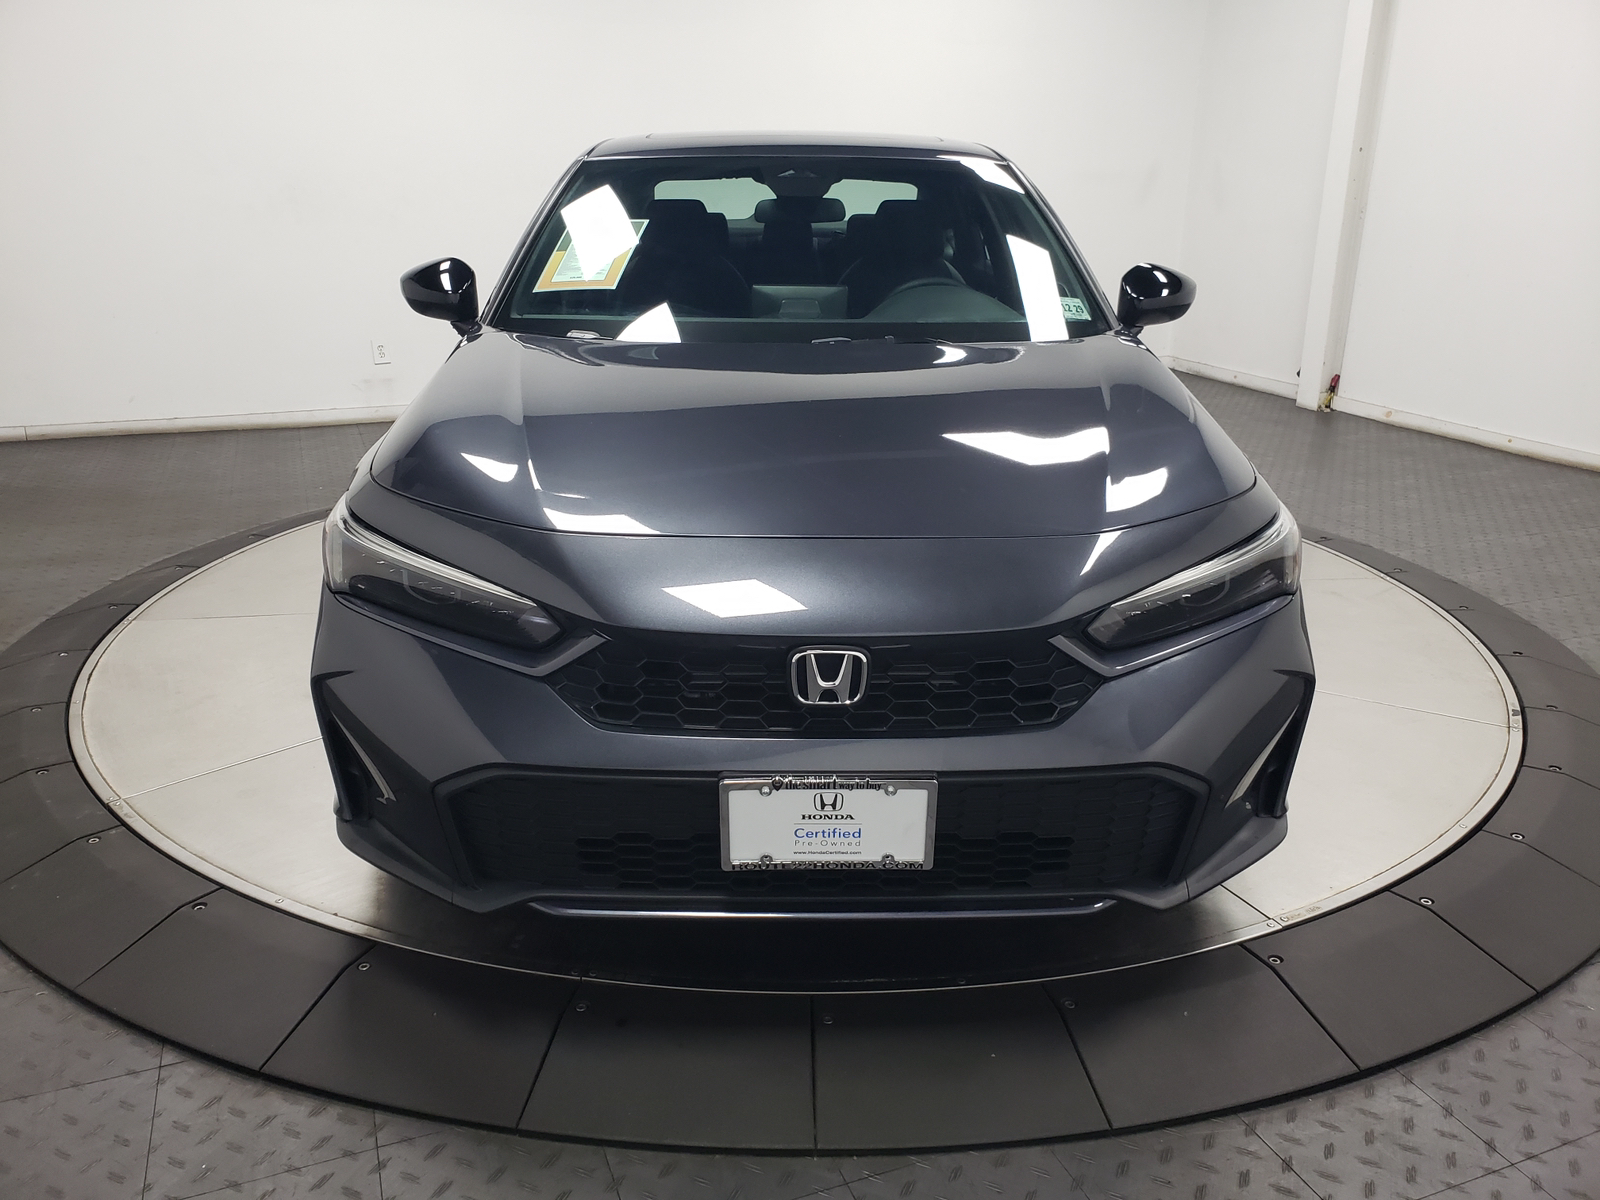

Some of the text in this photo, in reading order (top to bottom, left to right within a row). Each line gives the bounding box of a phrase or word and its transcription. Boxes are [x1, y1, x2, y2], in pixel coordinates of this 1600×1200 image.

[1073, 304, 1084, 314] 29
[785, 777, 882, 791] the smart way to buy
[794, 827, 861, 839] Certified
[794, 839, 861, 847] Pre-Owned
